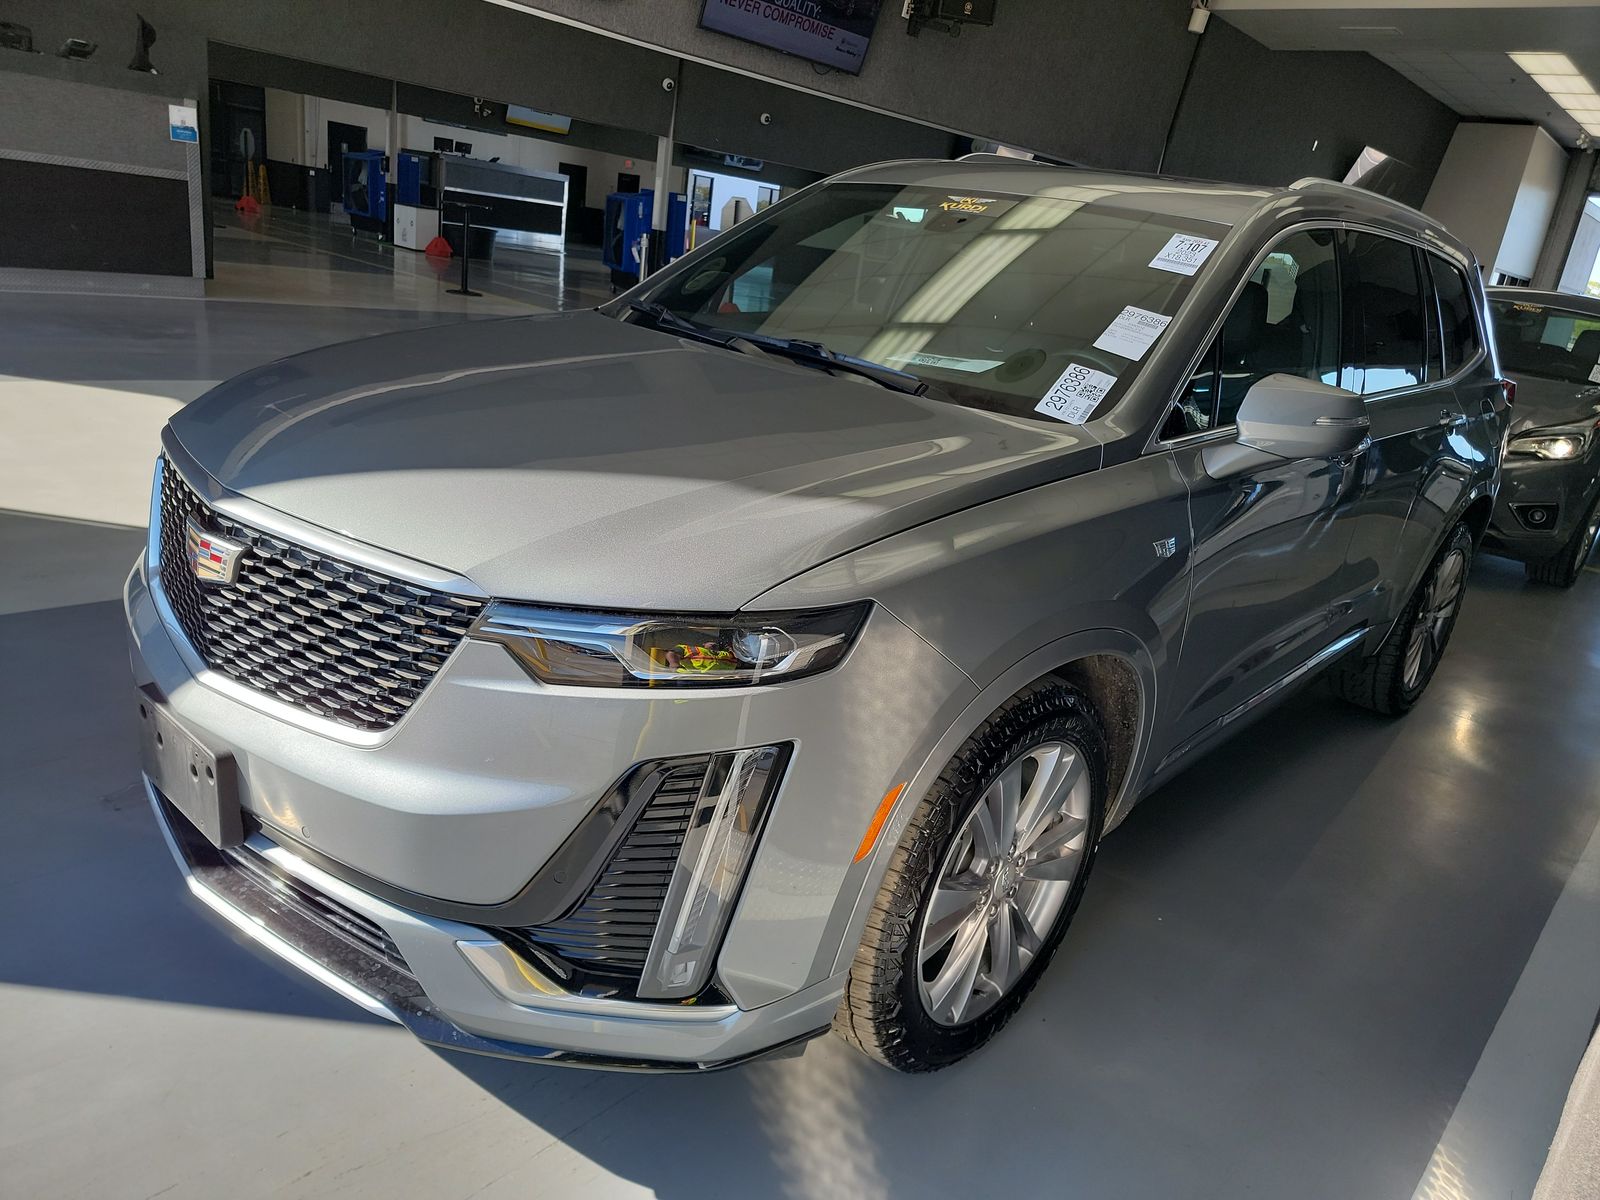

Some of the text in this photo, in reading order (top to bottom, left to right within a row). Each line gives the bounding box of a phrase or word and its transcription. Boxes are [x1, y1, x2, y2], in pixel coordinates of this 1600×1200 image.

[763, 5, 836, 40] COMPROMISE
[939, 202, 988, 212] KURDI
[1175, 241, 1207, 253] 7:107
[1121, 310, 1168, 327] 2976386
[1046, 366, 1090, 411] 2976386
[1067, 406, 1081, 419] DLR
